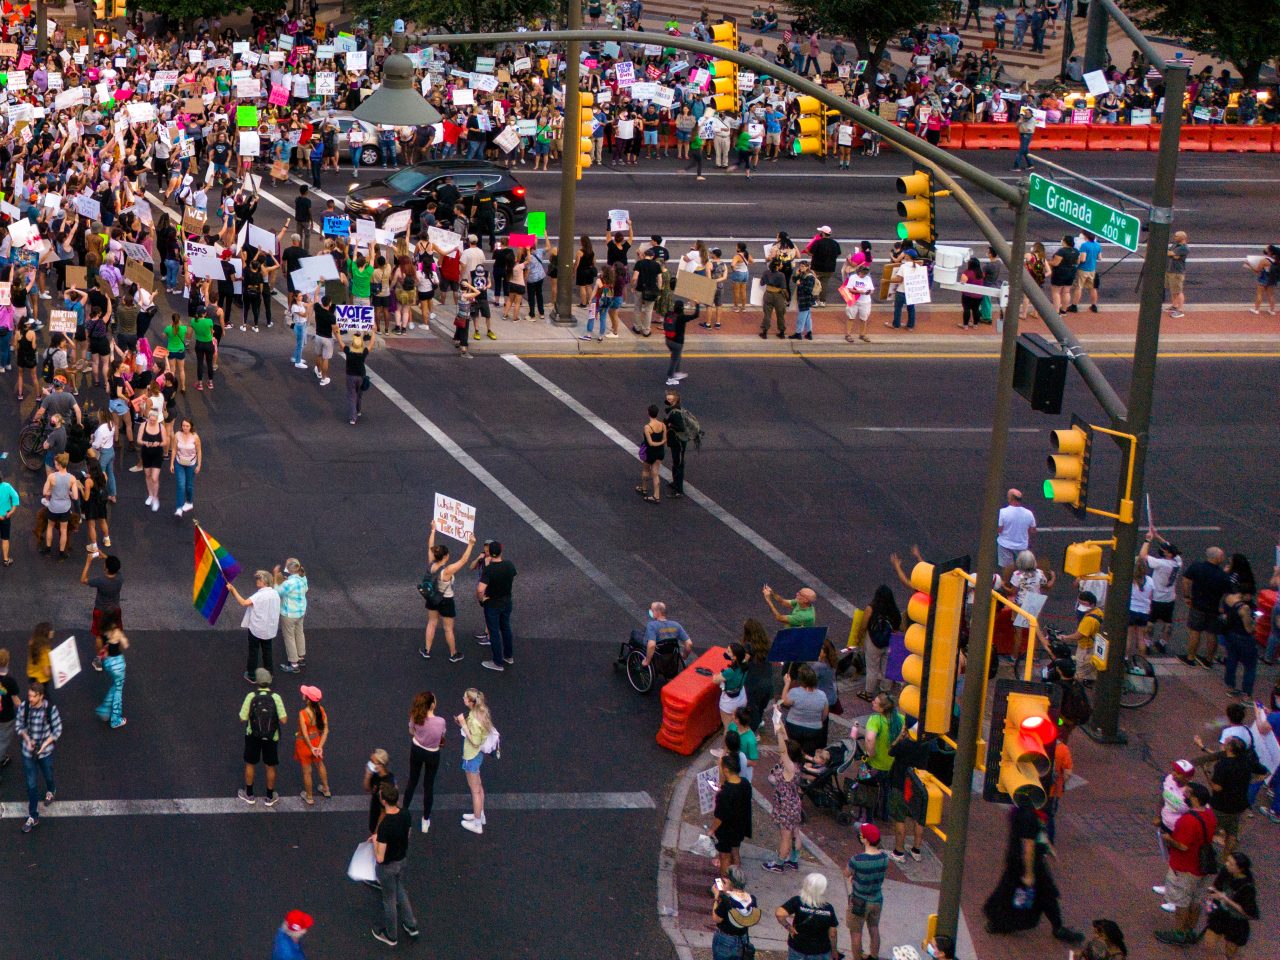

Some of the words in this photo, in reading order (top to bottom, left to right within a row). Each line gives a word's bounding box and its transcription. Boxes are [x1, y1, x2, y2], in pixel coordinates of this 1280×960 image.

[1034, 178, 1040, 189] S
[1046, 186, 1092, 224] Granada
[1109, 211, 1126, 229] Ave
[186, 208, 203, 220] WE
[1101, 223, 1119, 241] 400
[1124, 233, 1132, 246] W
[186, 242, 208, 254] Bans
[335, 306, 373, 320] VOTE
